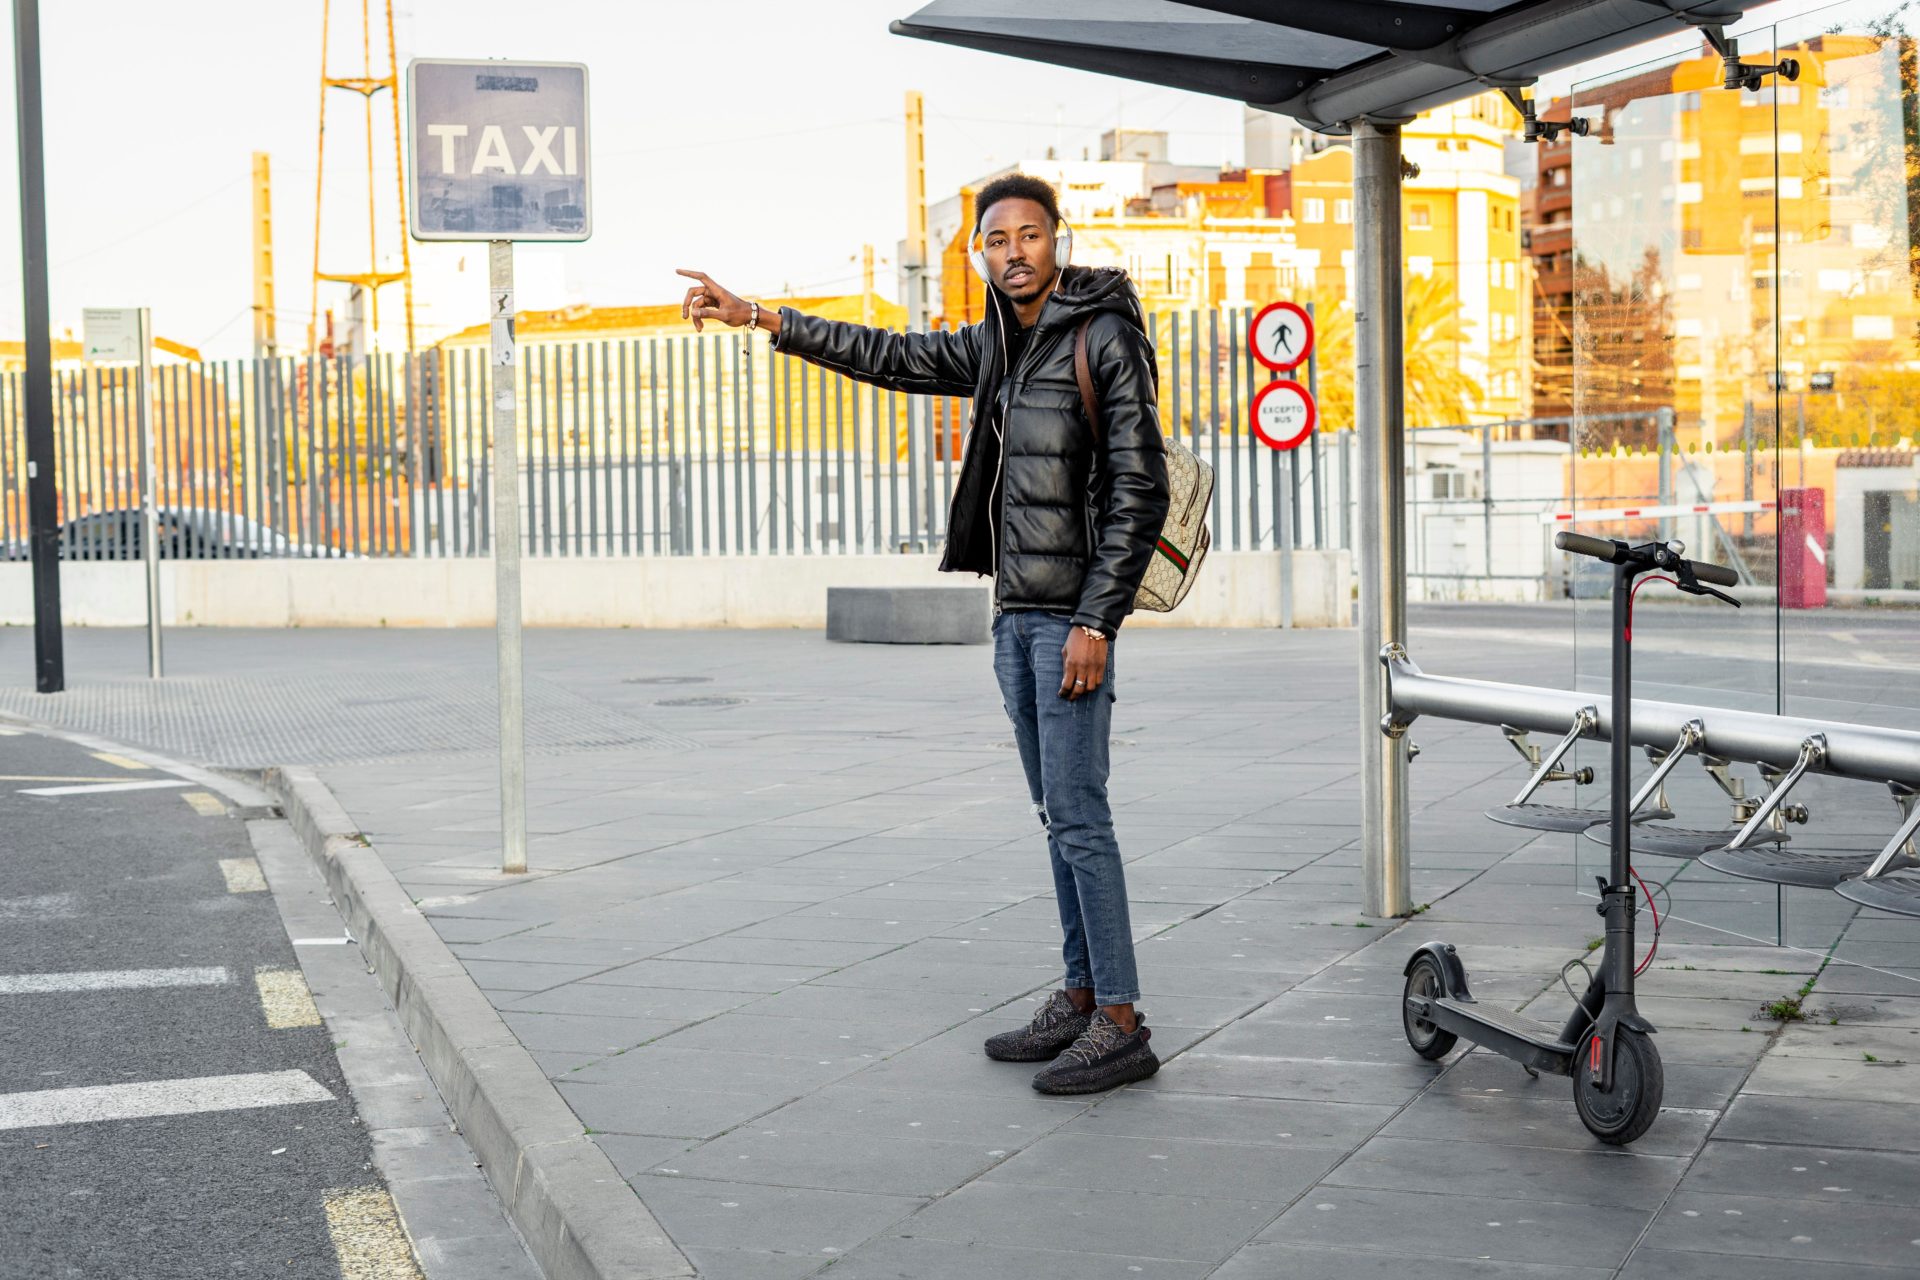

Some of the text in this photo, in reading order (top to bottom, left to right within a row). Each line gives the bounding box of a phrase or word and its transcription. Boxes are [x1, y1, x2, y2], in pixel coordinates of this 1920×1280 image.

[427, 124, 577, 175] TAXI
[1262, 405, 1304, 414] EXCEPTO
[1274, 416, 1292, 424] BUS
